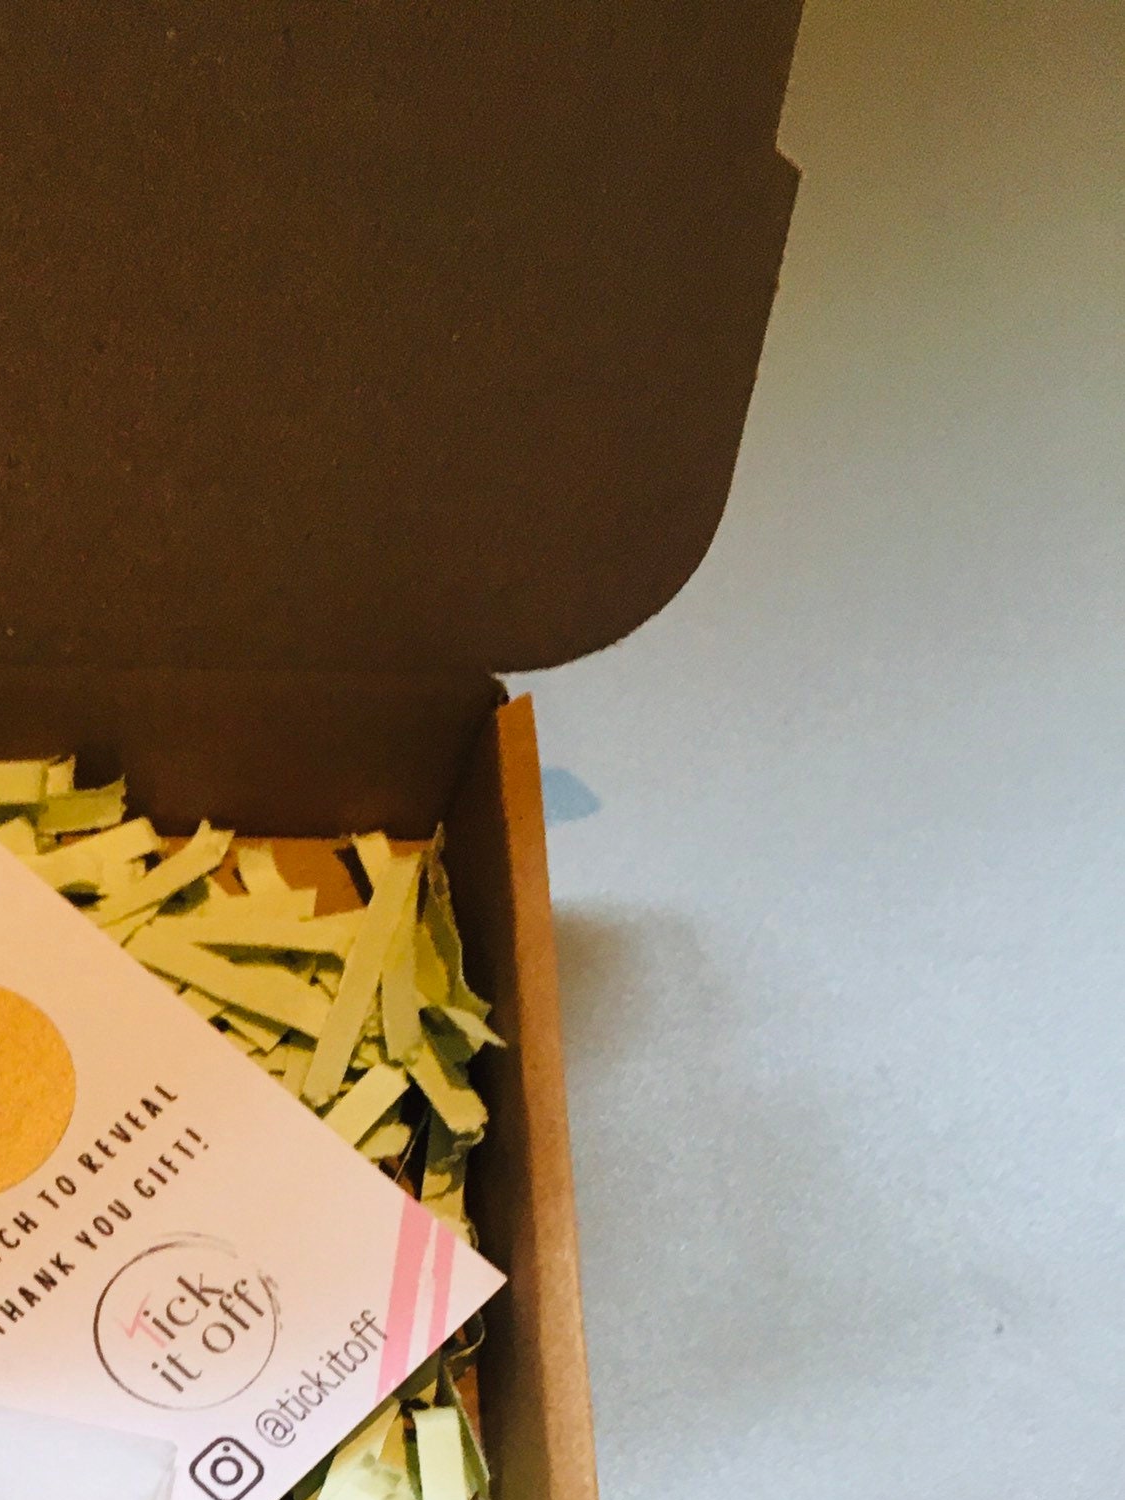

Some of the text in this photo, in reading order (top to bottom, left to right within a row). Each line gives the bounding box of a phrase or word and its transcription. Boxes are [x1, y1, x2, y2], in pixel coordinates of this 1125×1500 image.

[39, 1173, 77, 1211] TO
[77, 1083, 179, 1175] REVEAL
[75, 1198, 134, 1252] YOU
[133, 1127, 211, 1200] GIFT!
[122, 1270, 226, 1349] Tick
[151, 1278, 268, 1394] it off
